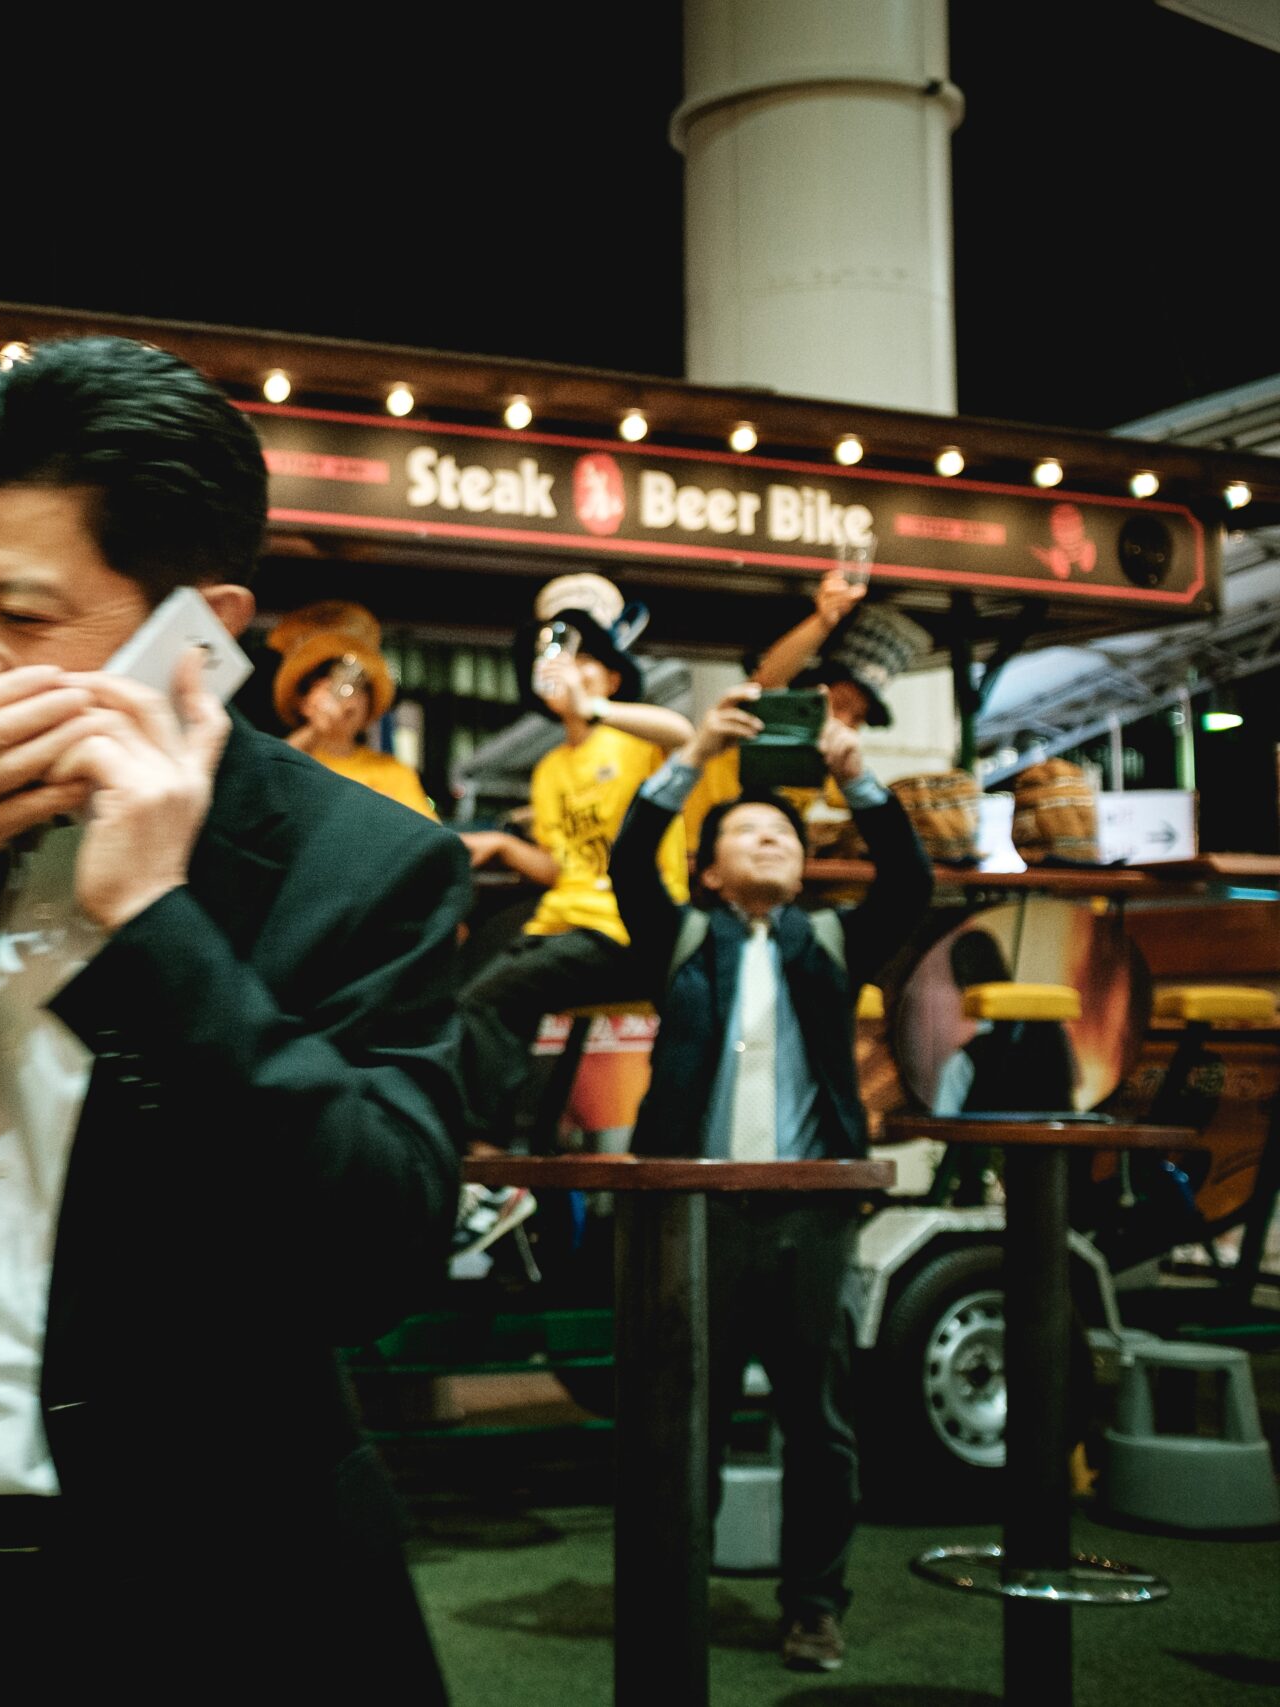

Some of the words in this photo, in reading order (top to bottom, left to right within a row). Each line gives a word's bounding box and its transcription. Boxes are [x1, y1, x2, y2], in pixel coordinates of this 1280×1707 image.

[406, 446, 558, 518] Steak
[639, 470, 761, 536] Beer
[767, 484, 875, 547] Bike
